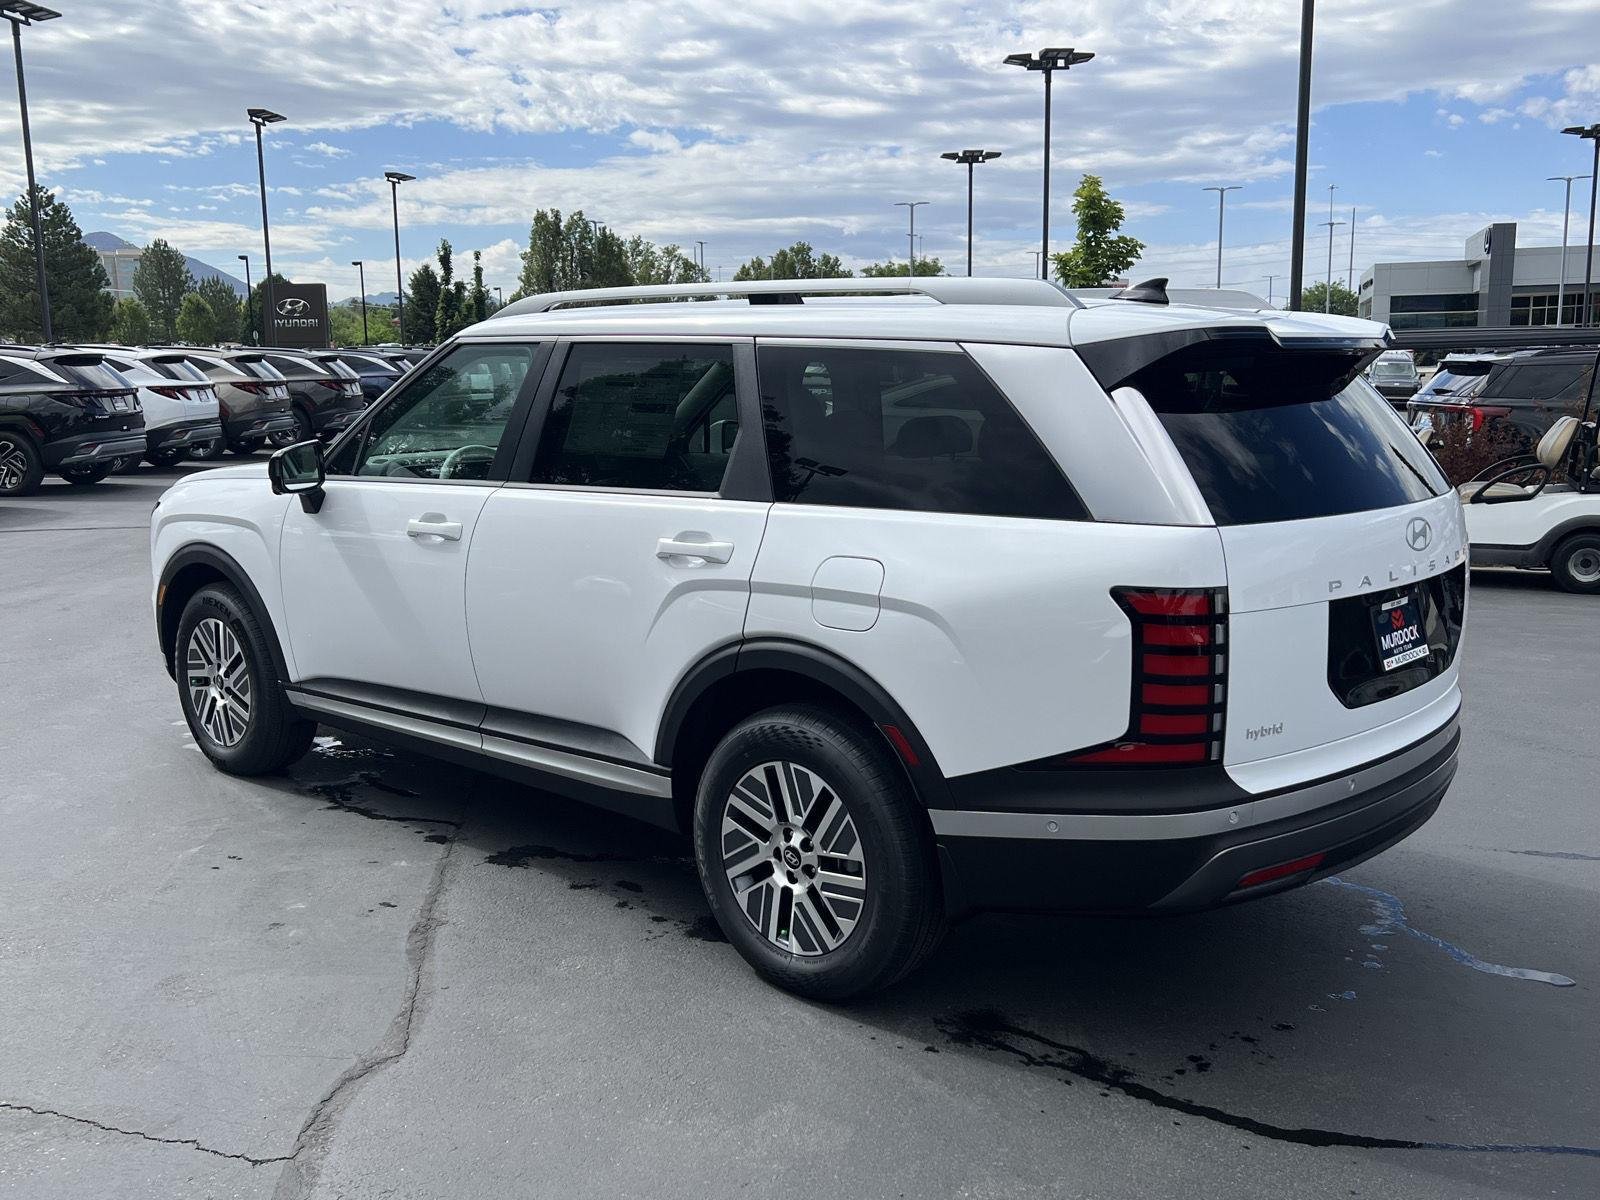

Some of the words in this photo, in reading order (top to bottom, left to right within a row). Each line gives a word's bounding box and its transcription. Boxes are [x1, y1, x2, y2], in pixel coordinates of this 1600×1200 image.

[202, 596, 231, 619] NEXEN
[1381, 624, 1420, 651] MURDOCK
[1246, 722, 1284, 741] hybrid
